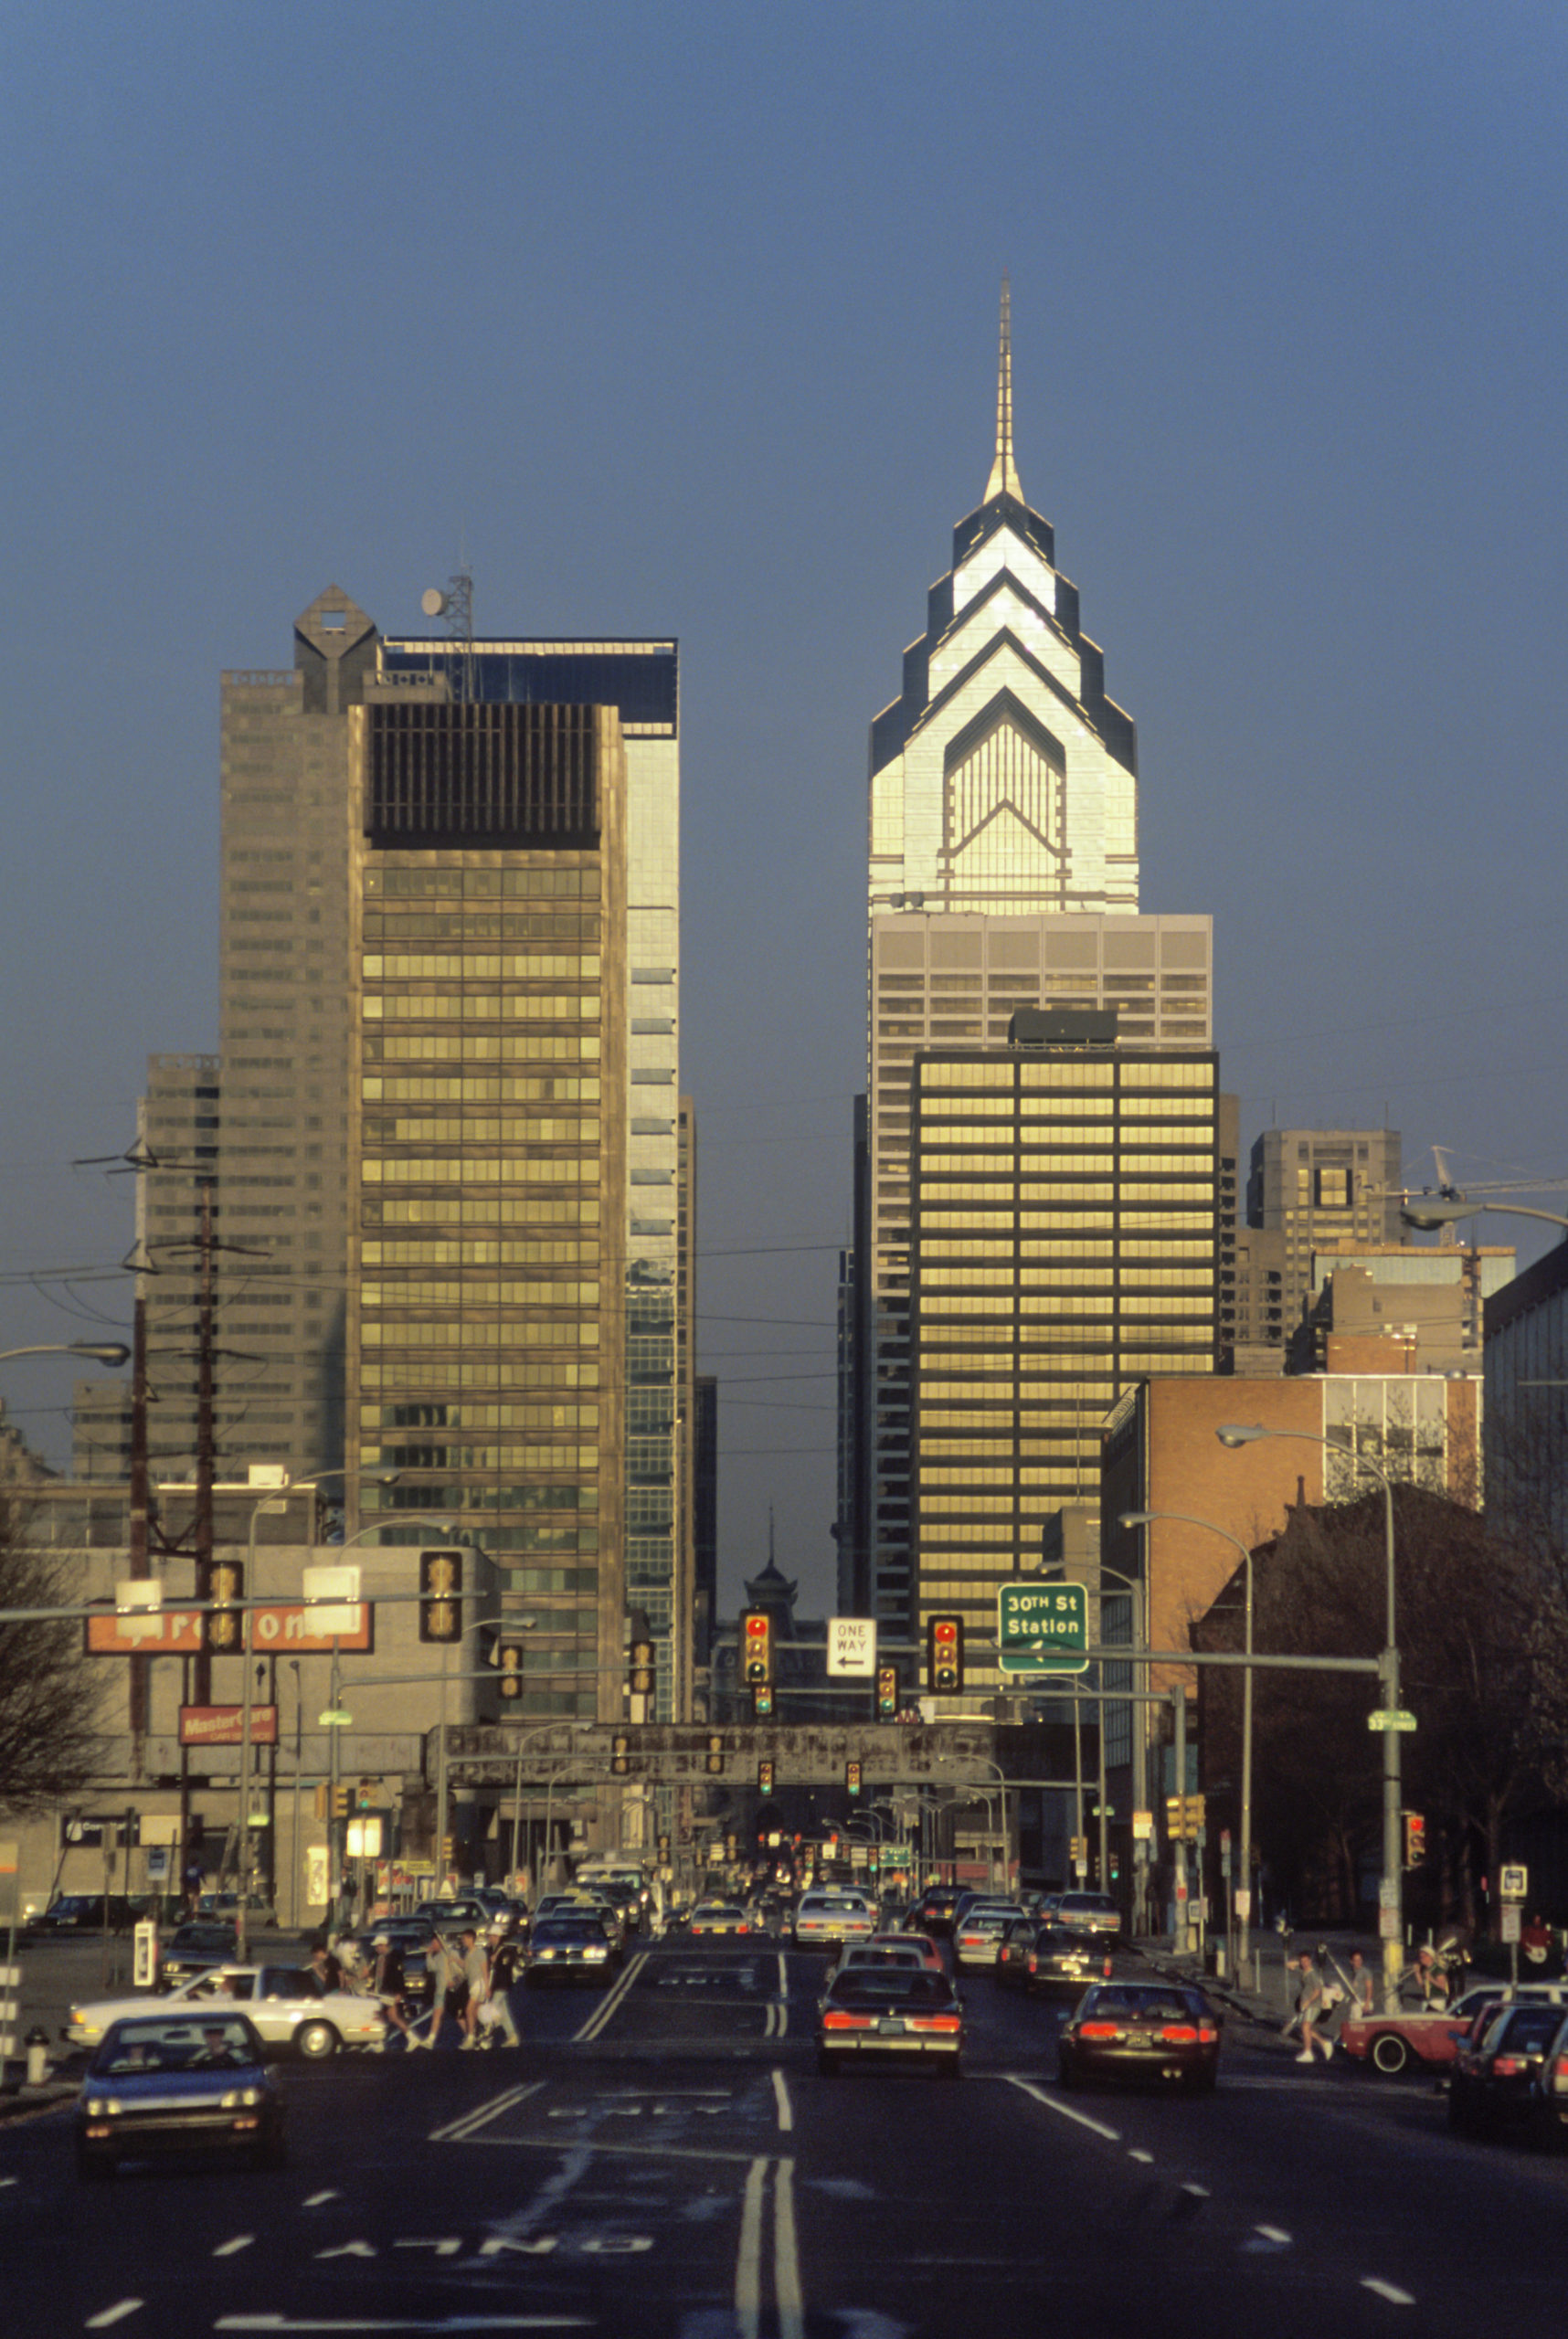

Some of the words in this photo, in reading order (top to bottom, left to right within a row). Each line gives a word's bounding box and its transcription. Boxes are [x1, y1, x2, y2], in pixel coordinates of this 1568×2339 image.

[1008, 1595, 1049, 1612] 30TH
[1055, 1595, 1077, 1611] St
[838, 1625, 865, 1637] ONE
[1008, 1618, 1079, 1635] Station
[837, 1639, 866, 1652] WAY
[232, 1731, 271, 1741] SEICE
